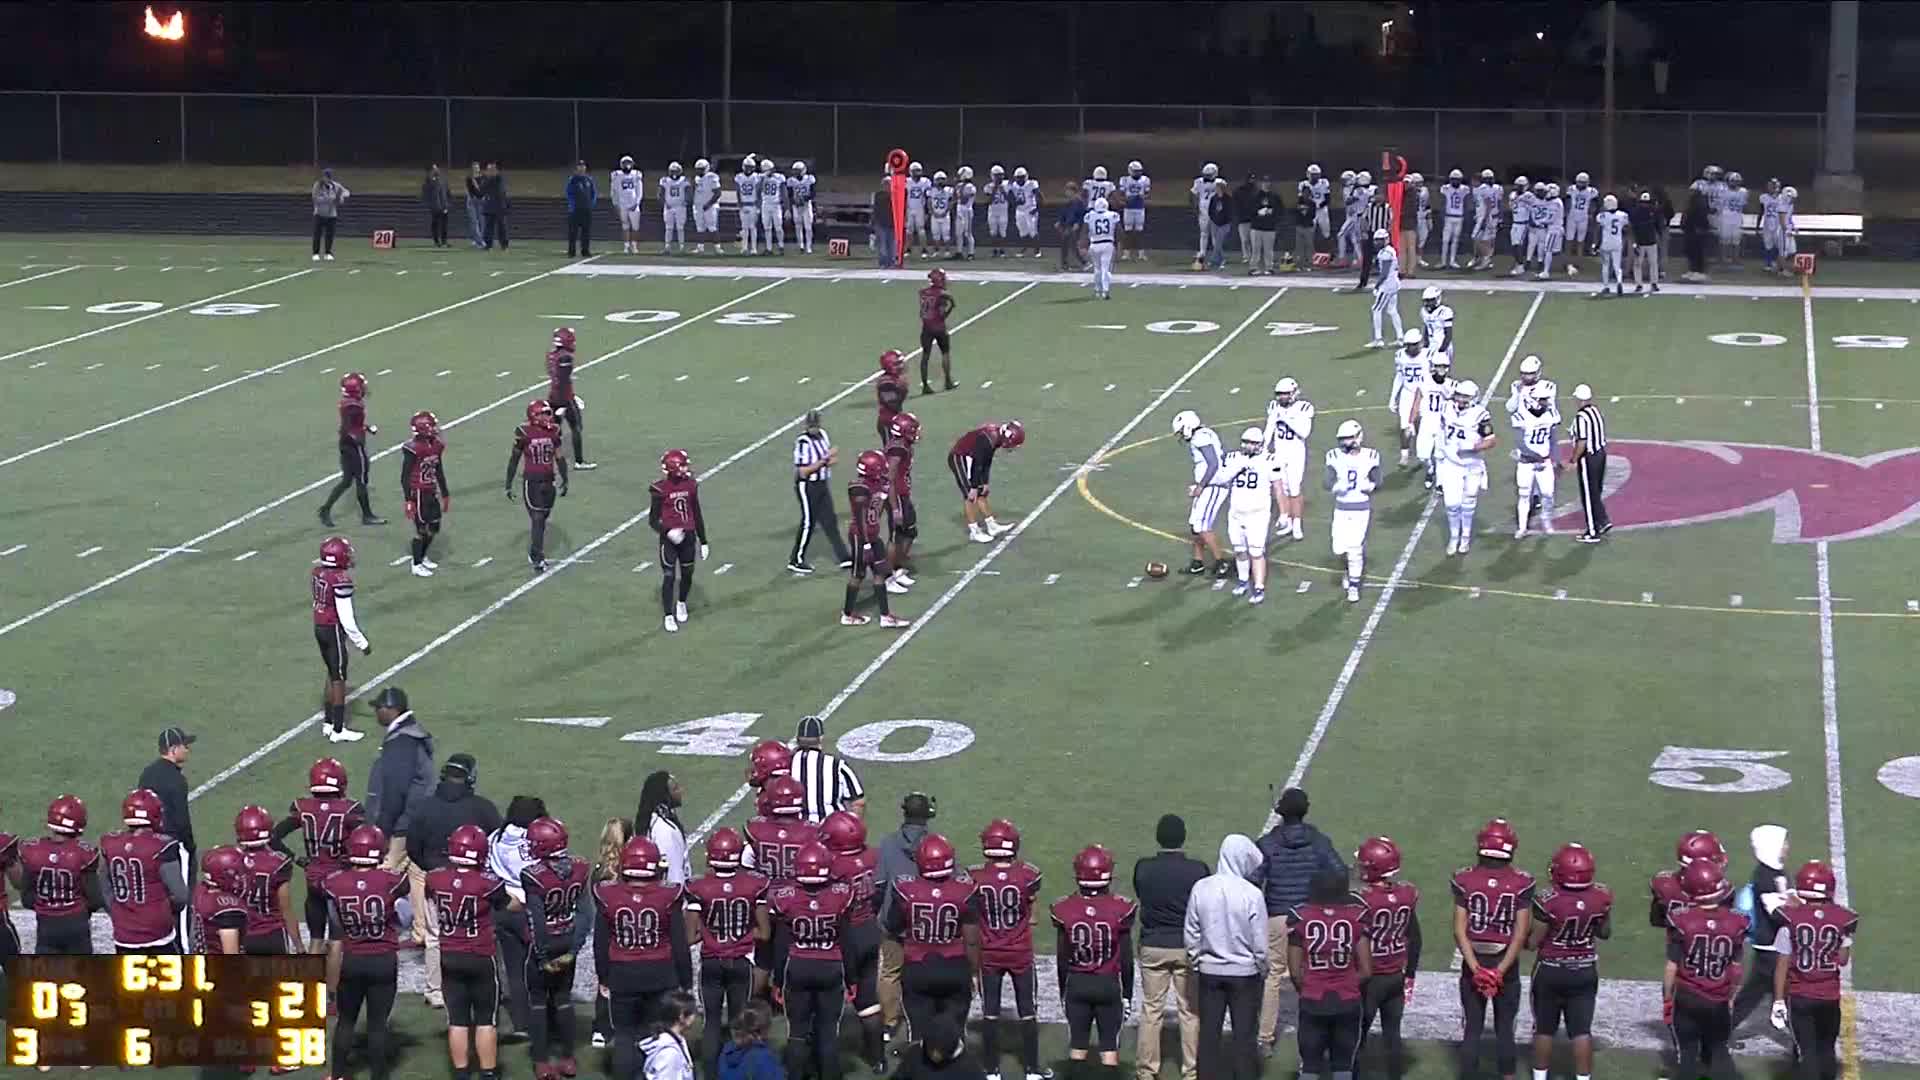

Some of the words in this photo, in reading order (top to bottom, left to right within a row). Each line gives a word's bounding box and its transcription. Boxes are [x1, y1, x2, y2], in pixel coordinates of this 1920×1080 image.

[1095, 219, 1110, 235] 63
[1611, 219, 1618, 235] 5
[673, 497, 689, 521] 9
[301, 812, 345, 858] 14
[111, 856, 145, 903] 61
[339, 895, 386, 940] 53
[615, 906, 660, 951] 63
[707, 898, 750, 943] 40
[912, 903, 958, 944] 56
[980, 884, 1020, 930] 18
[1071, 921, 1112, 967] 31
[1305, 919, 1353, 970] 23
[1370, 907, 1412, 958] 22
[1796, 923, 1840, 971] 82
